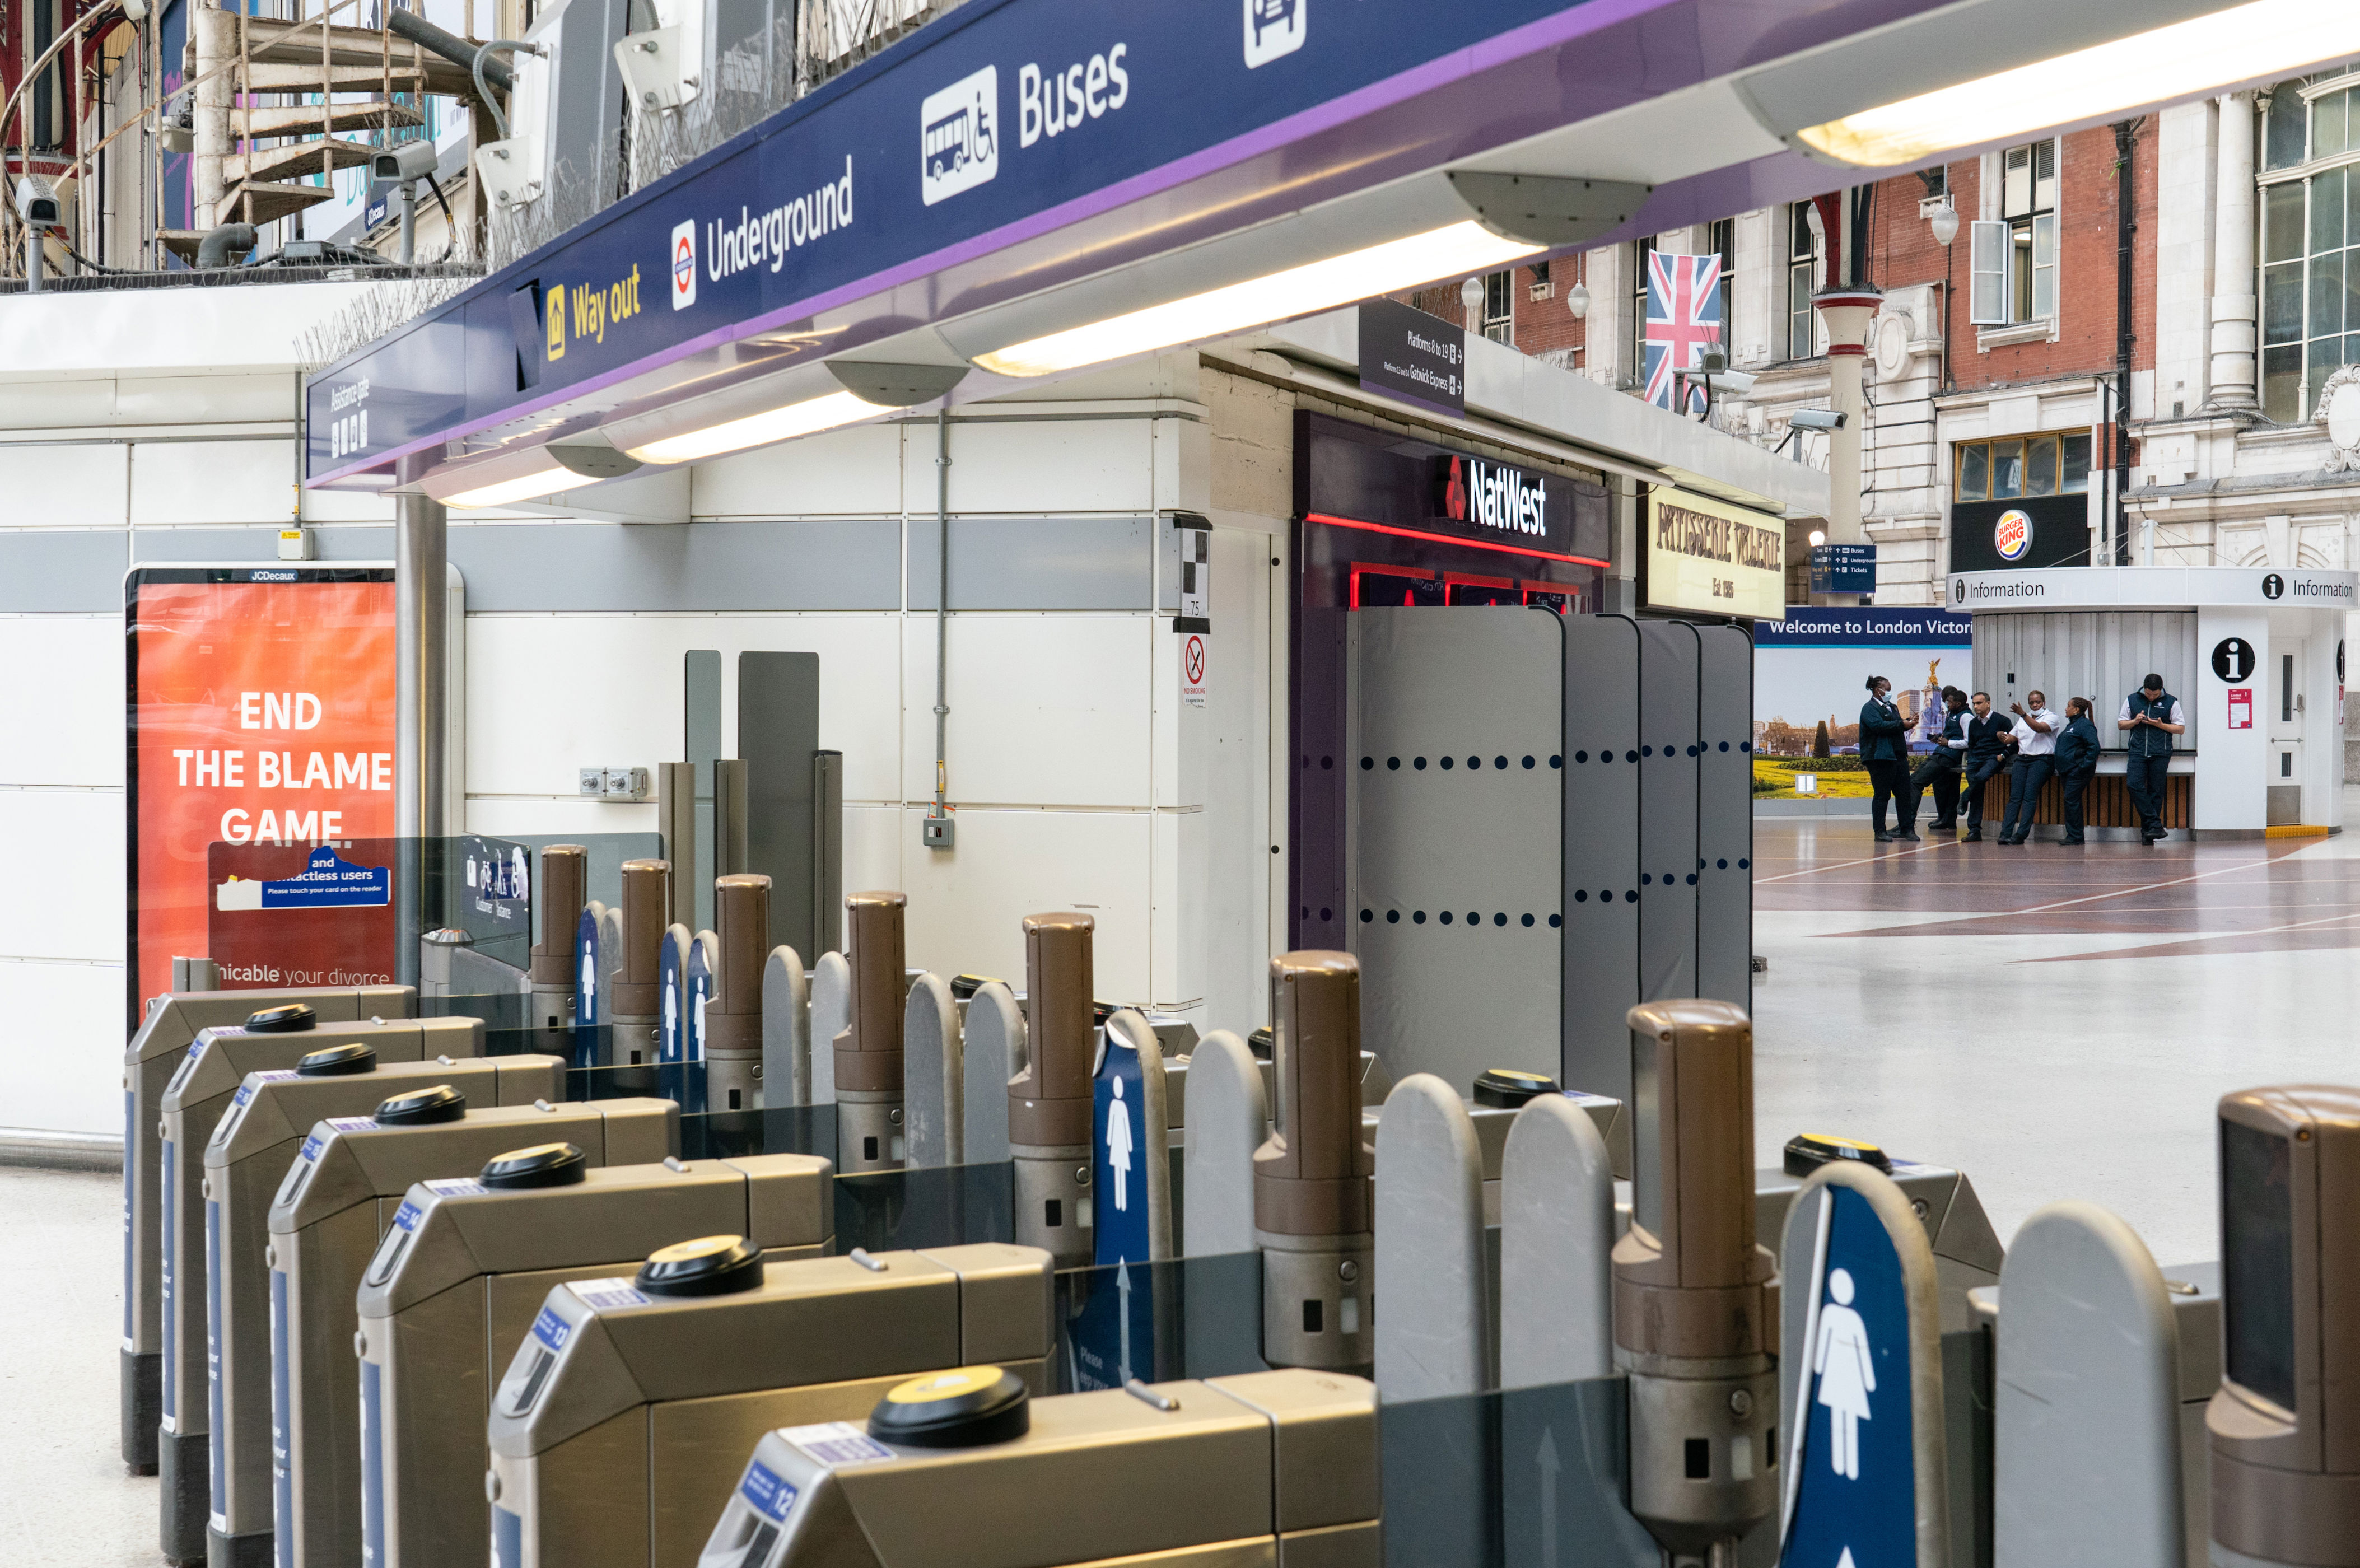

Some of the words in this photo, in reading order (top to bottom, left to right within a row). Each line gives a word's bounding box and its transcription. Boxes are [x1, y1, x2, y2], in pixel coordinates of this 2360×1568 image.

[1019, 41, 1129, 150] Buses
[708, 153, 853, 282] Underground
[572, 282, 607, 344] Way
[610, 262, 641, 324] out
[1407, 330, 1431, 353] Platforms
[1431, 339, 1435, 354] 8
[1435, 342, 1442, 357] to
[1442, 343, 1449, 359] 19
[1410, 363, 1429, 384] Gatwick
[1430, 370, 1448, 390] Express
[1470, 459, 1546, 537] NatWest
[1657, 502, 1732, 563] PATISSERIE
[1733, 521, 1781, 573] VALERIE
[1998, 518, 2023, 538] BURGER
[1999, 526, 2024, 550] KING
[251, 571, 295, 581] JCDecaux
[2294, 579, 2353, 598] Information
[1970, 581, 2044, 598] Information
[1191, 600, 1199, 616] 75
[1769, 619, 1841, 634] Welcome
[1845, 621, 1862, 634] to
[1866, 619, 1922, 634] London
[240, 692, 322, 730] END
[172, 749, 244, 787] THE
[258, 750, 391, 791] BLAME
[220, 808, 352, 850] GAME.
[311, 857, 335, 868] and
[341, 871, 374, 880] users
[284, 970, 324, 987] your
[328, 968, 390, 986] divorce
[553, 1325, 569, 1347] 13
[773, 1487, 795, 1516] 12
